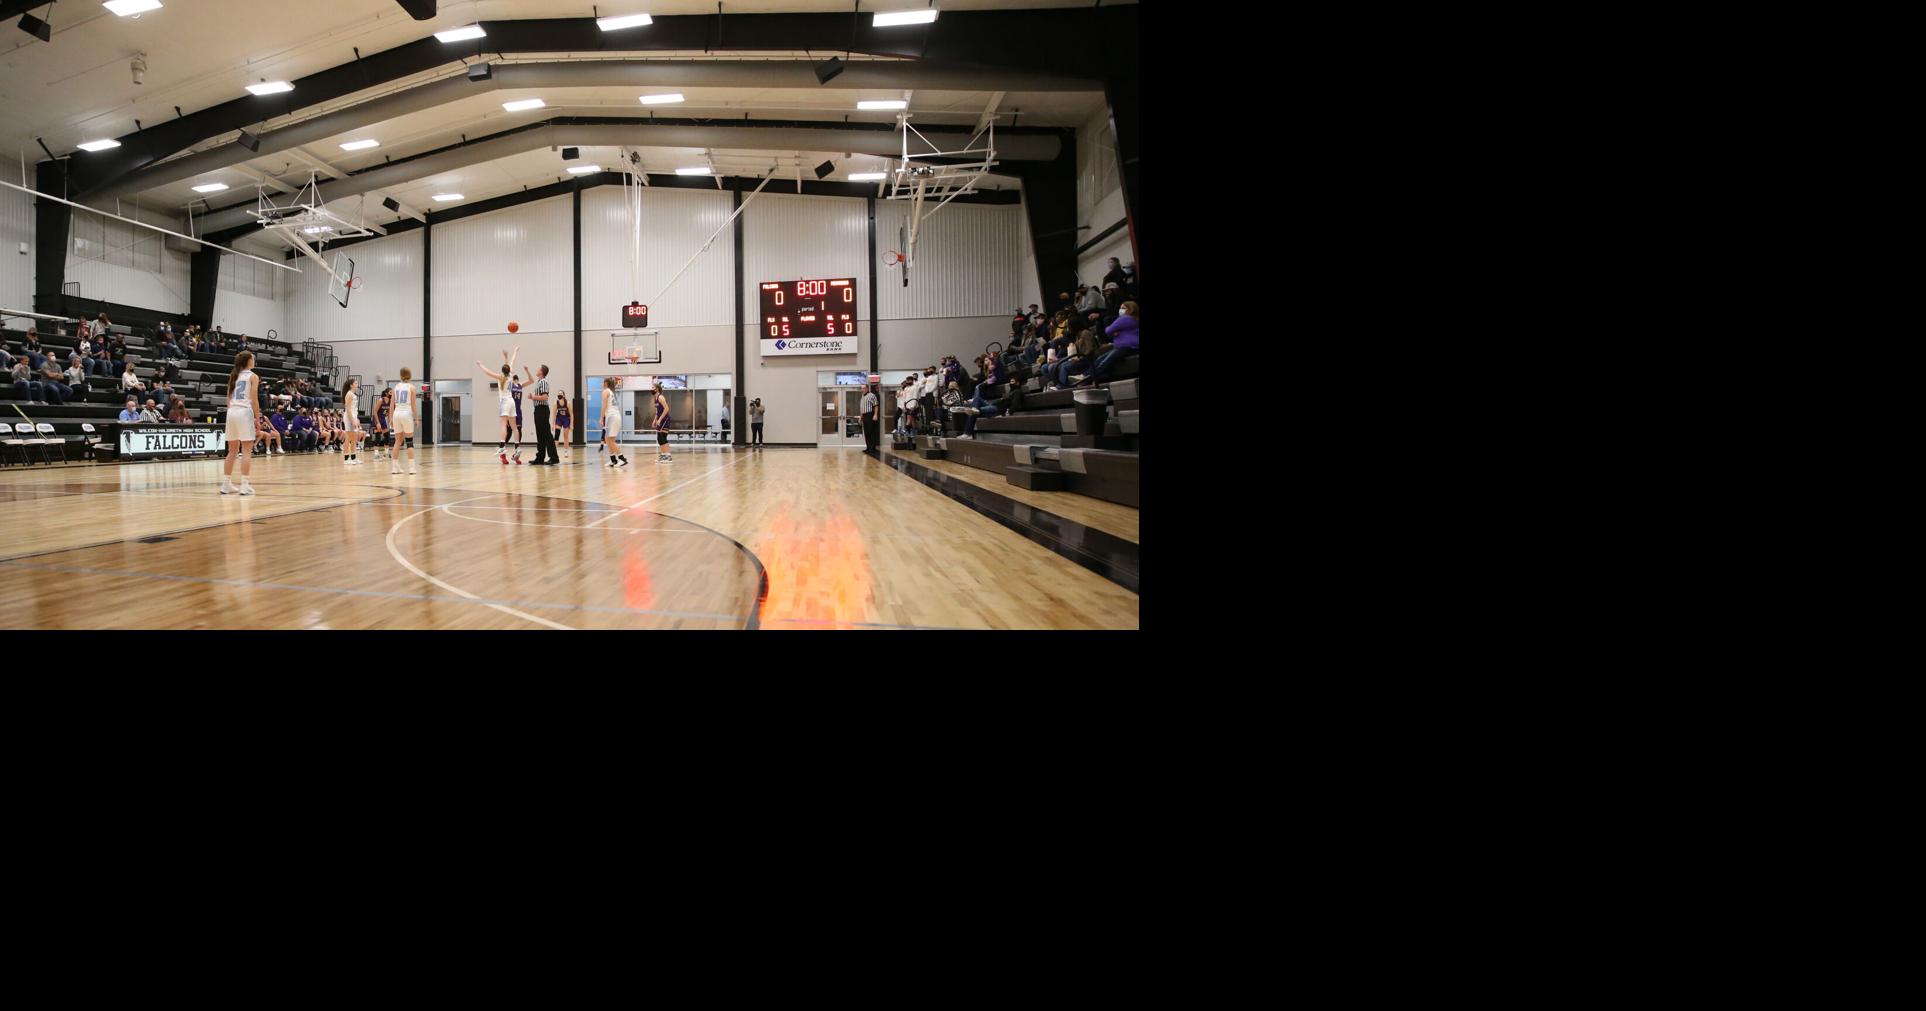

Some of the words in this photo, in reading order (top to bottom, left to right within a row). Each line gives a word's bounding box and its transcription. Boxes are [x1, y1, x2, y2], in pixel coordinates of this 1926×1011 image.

[797, 281, 826, 295] 8:00
[775, 291, 784, 305] 0
[843, 287, 852, 302] 0
[629, 306, 646, 315] 8:00
[771, 325, 778, 336] 0
[782, 324, 789, 336] 5
[827, 323, 834, 334] 5
[845, 322, 852, 334] 0
[788, 340, 842, 349] Cornerstone
[145, 434, 205, 450] FALCONS
